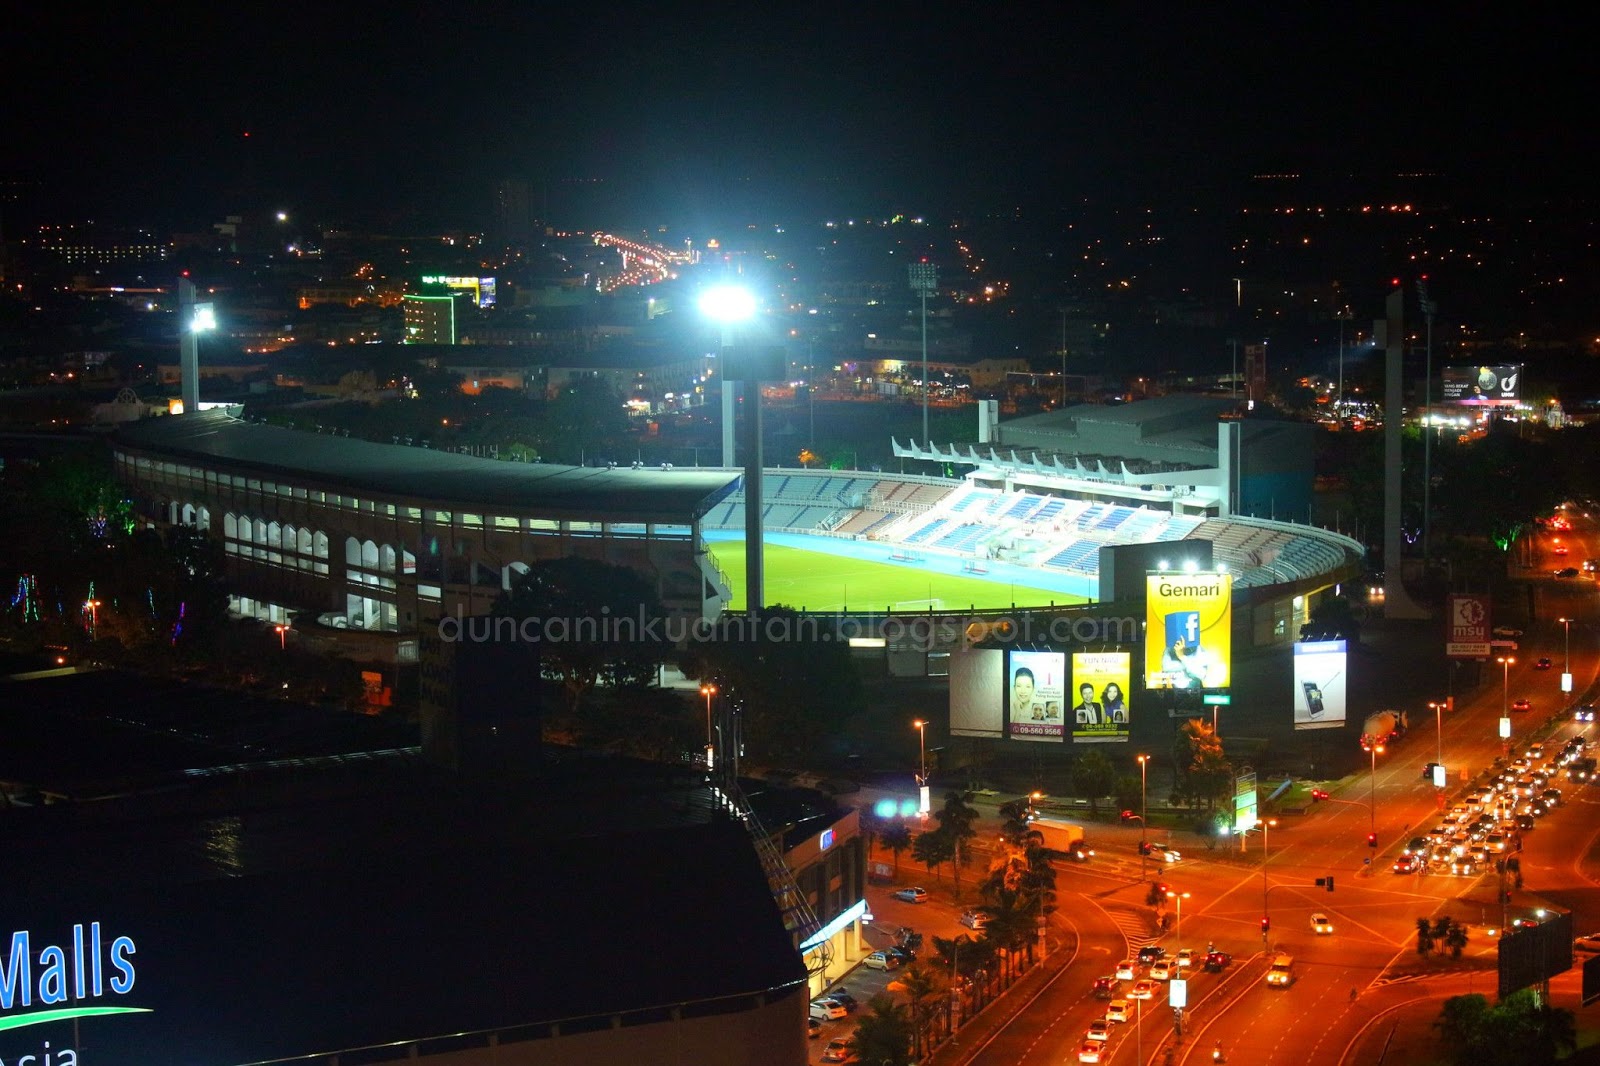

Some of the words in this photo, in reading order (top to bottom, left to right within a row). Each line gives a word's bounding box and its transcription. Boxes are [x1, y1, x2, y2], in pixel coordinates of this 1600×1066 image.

[1160, 583, 1220, 597] Gemari
[1453, 626, 1484, 636] msu
[0, 921, 136, 1009] Malls
